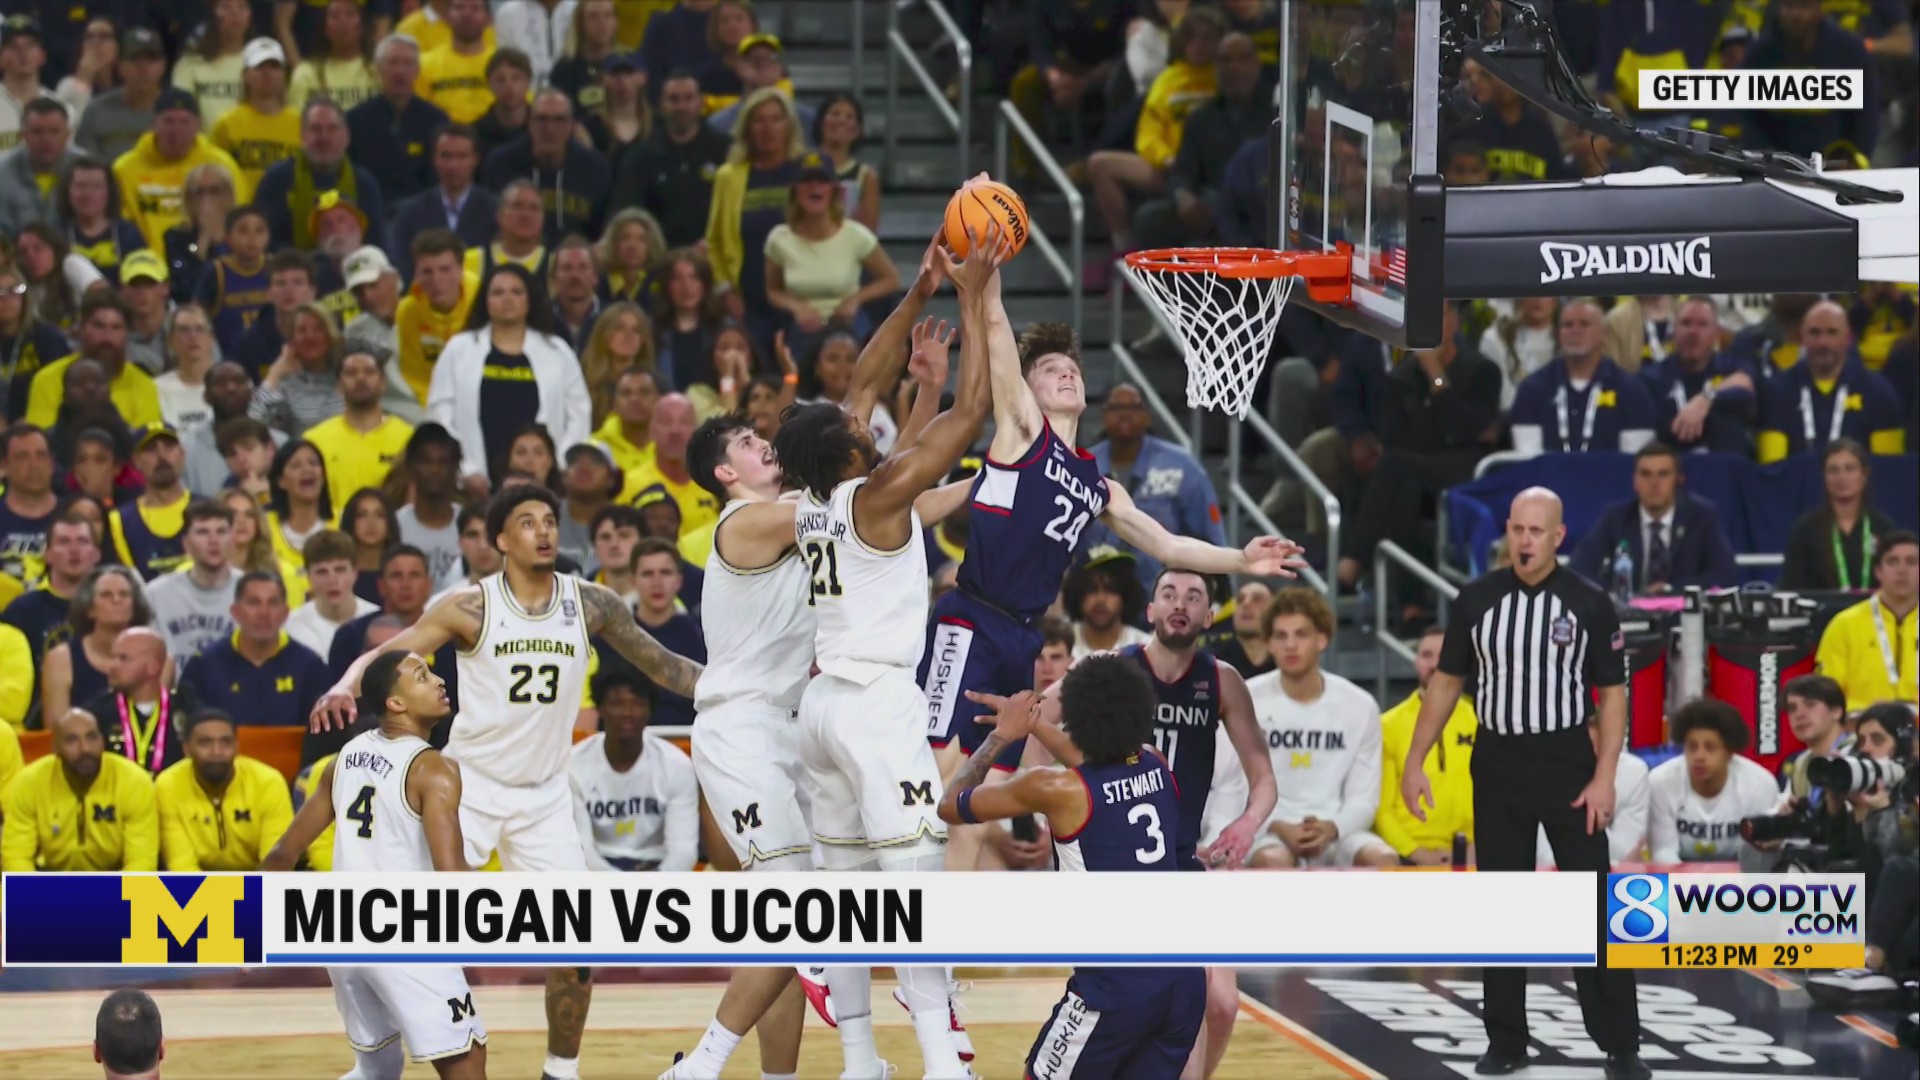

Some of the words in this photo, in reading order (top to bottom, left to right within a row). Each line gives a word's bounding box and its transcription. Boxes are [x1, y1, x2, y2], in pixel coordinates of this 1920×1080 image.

[1540, 236, 1711, 284] SPALDING
[1044, 458, 1106, 517] UCONN
[796, 513, 829, 541] OHNSON
[1043, 494, 1090, 552] 24
[806, 541, 843, 595] 21
[494, 638, 576, 658] MICHIGAN
[509, 663, 560, 704] 23
[927, 631, 960, 730] HUSKIES
[1153, 703, 1209, 727] ONN
[1153, 727, 1178, 772] 11
[1269, 730, 1303, 749] OCK
[1307, 731, 1321, 749] IT
[345, 751, 394, 780] BURNETT
[1102, 767, 1165, 805] STEWART
[346, 785, 376, 839] 4
[902, 780, 935, 806] M
[732, 802, 763, 834] M
[1127, 802, 1167, 865] 3
[447, 991, 476, 1023] M
[1042, 999, 1088, 1080] HUSKIES
